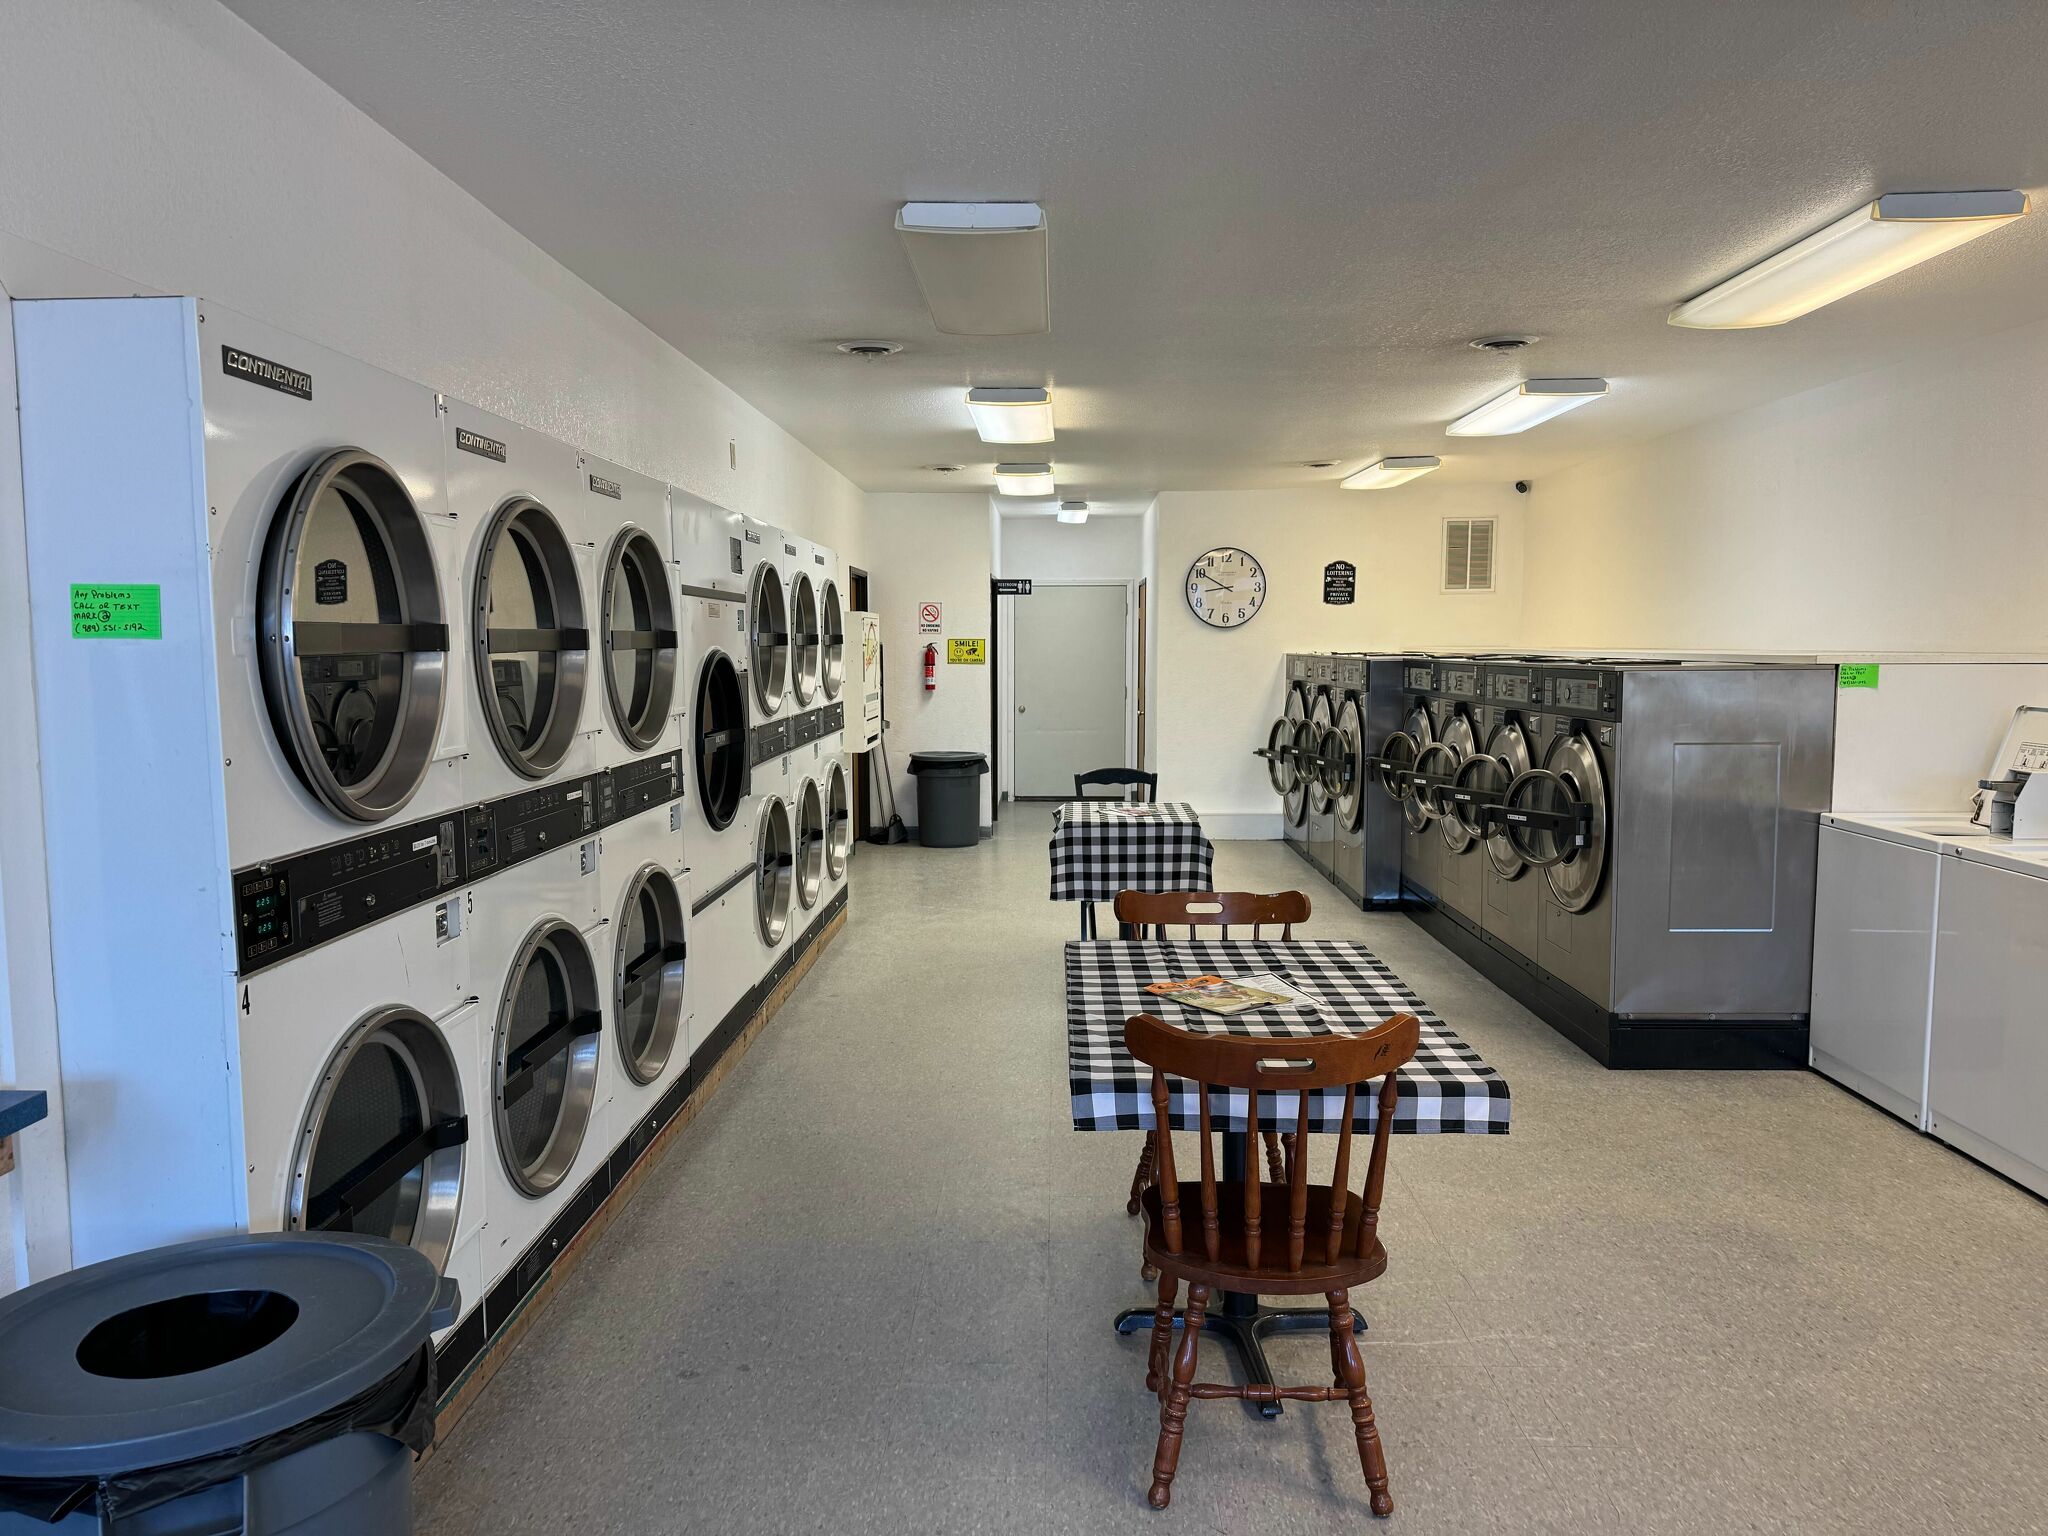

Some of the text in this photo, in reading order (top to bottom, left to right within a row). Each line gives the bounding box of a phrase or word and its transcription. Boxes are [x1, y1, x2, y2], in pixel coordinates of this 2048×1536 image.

[227, 351, 312, 392] CONTINENTAL
[1207, 556, 1214, 567] 11
[1221, 553, 1232, 563] 12
[1240, 556, 1244, 567] 1
[1195, 568, 1206, 578] 10
[1249, 567, 1257, 578] 2
[1190, 583, 1198, 593] 9
[1254, 582, 1261, 592] 3
[75, 589, 131, 600] Any Problems
[1195, 597, 1203, 608] 8
[1249, 596, 1256, 607] 4
[1207, 608, 1215, 619] 7
[1221, 612, 1230, 624] 6
[1238, 607, 1246, 618] 5
[467, 891, 473, 914] 5
[241, 984, 251, 1015] 4
